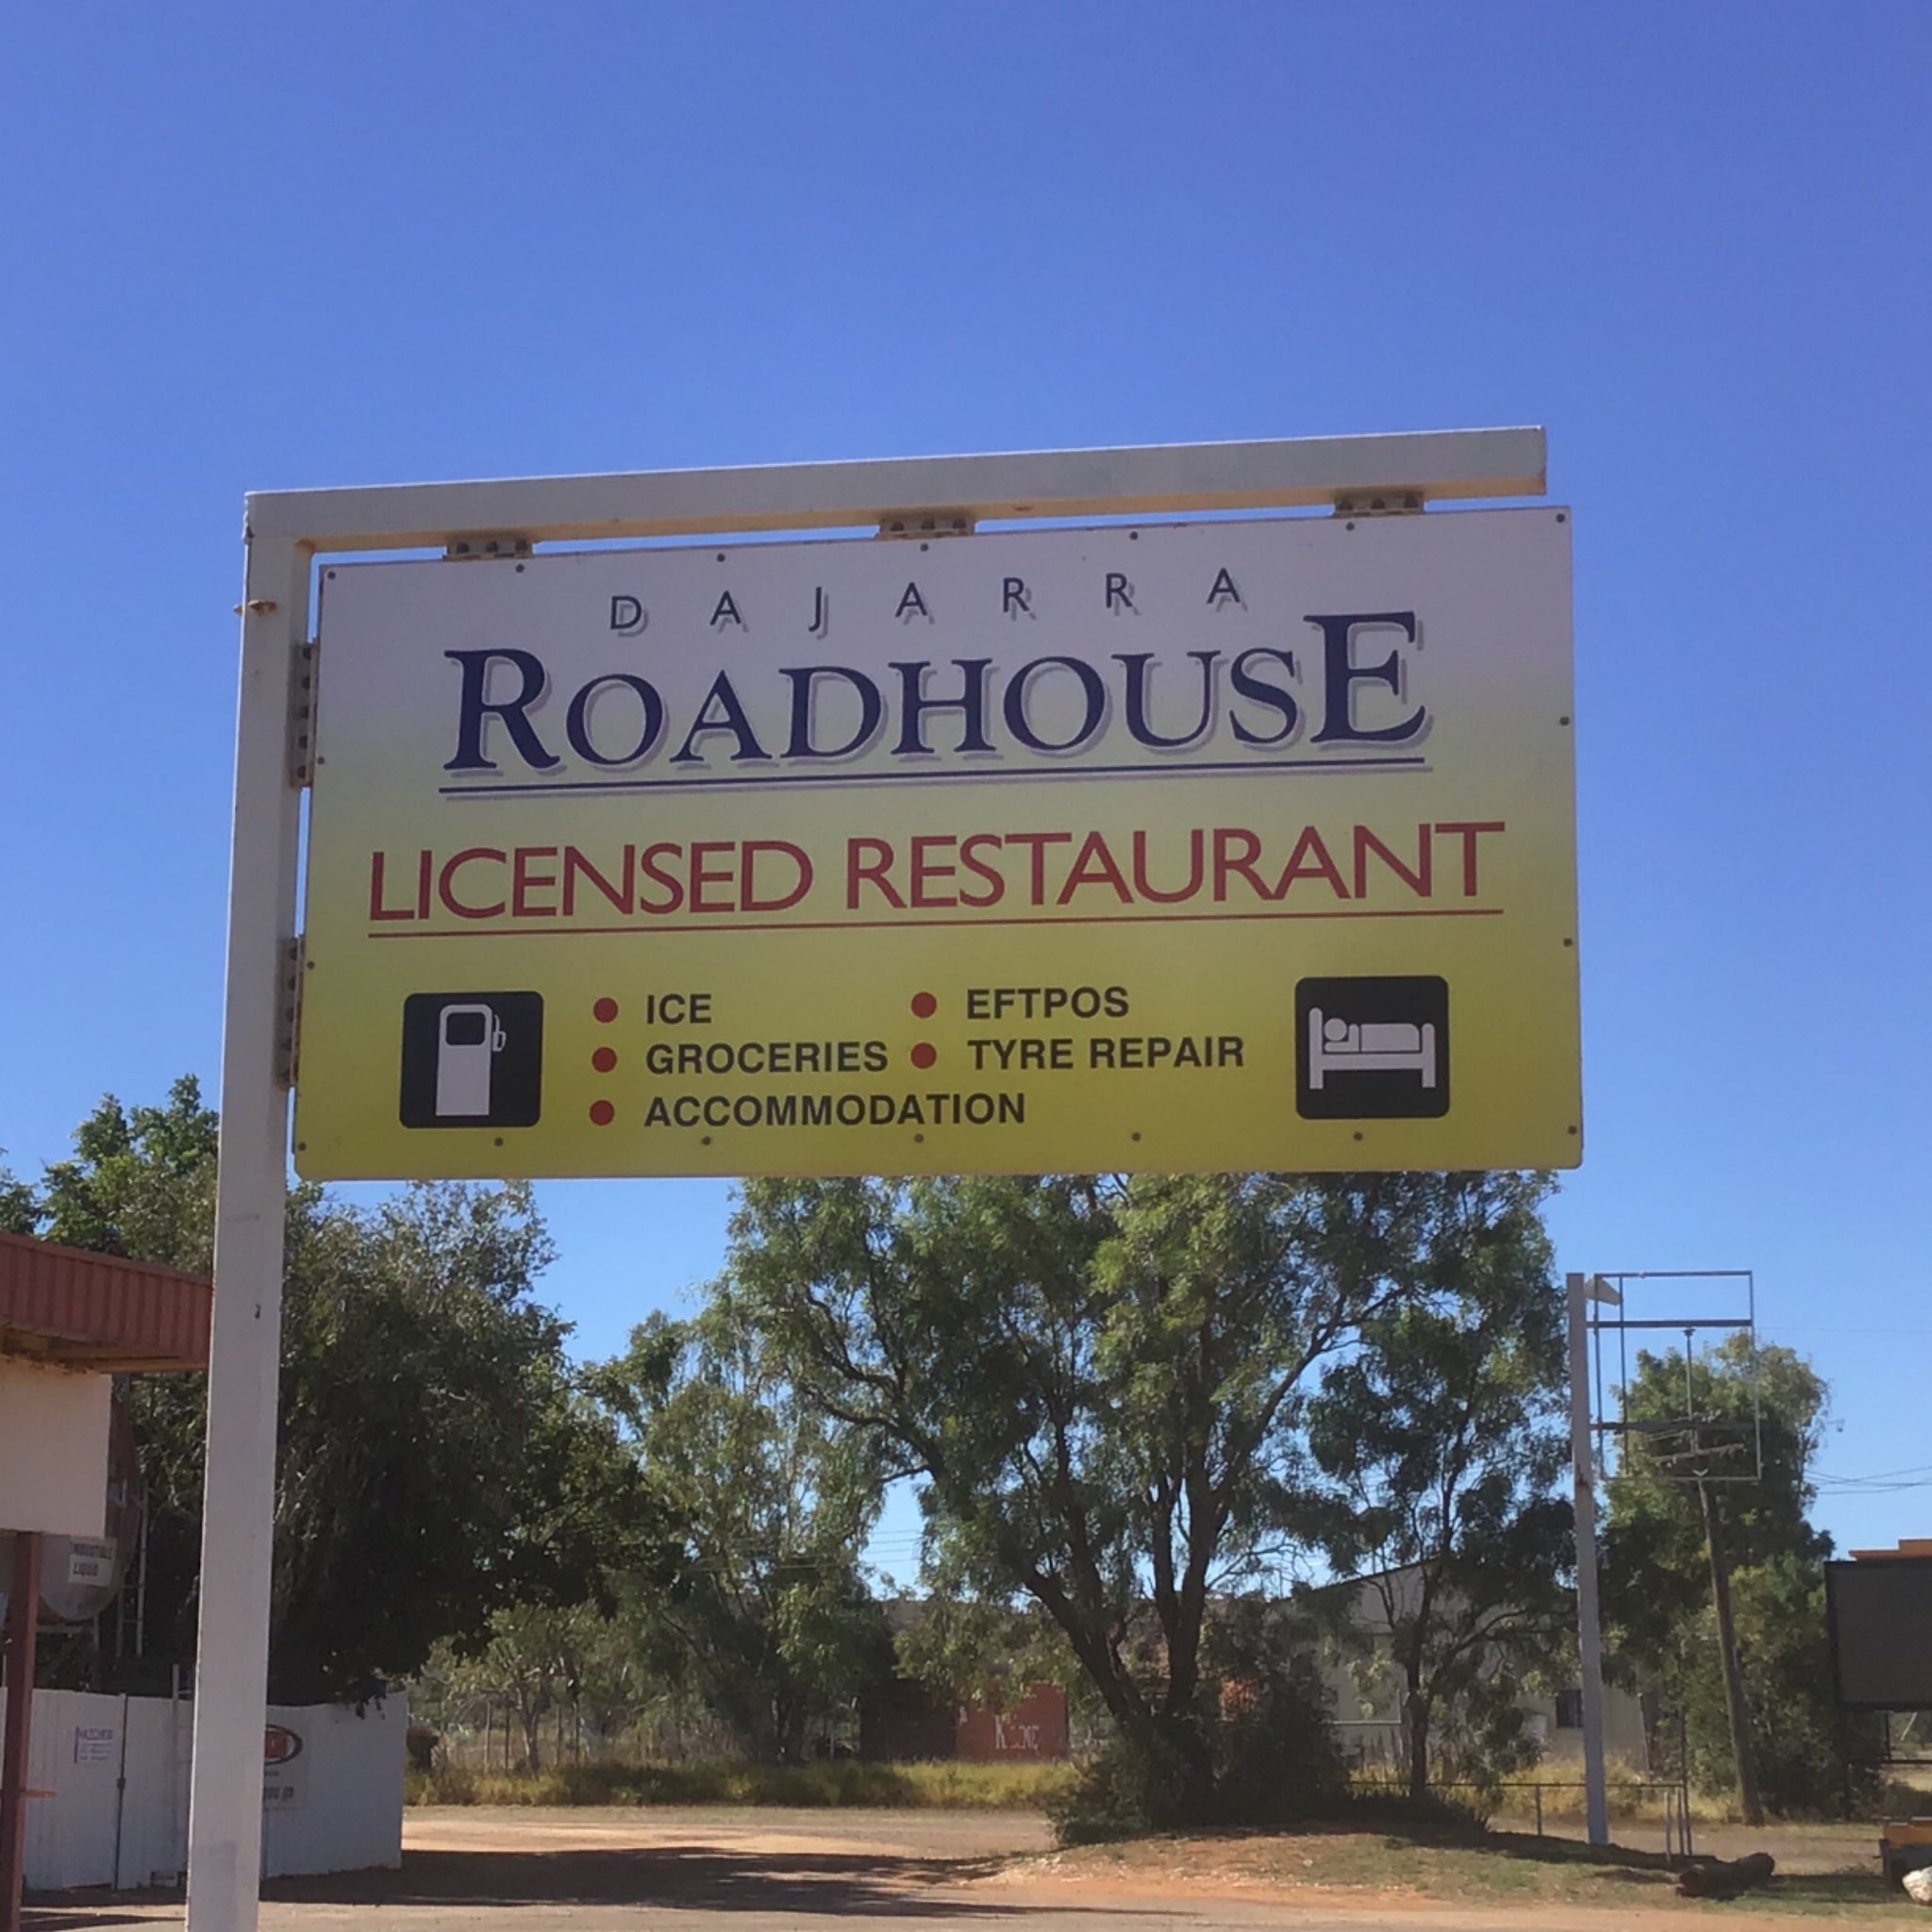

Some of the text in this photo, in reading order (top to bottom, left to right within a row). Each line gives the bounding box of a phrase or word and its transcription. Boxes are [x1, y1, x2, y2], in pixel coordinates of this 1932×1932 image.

[609, 568, 1243, 632] DAJARRA
[443, 611, 1426, 772] ROADHOUSE
[369, 822, 1506, 921] LICENSED RESTAURANT
[646, 993, 712, 1024] ICE
[966, 986, 1130, 1020] EFTPOS
[646, 1041, 889, 1074] GROCERIES
[967, 1036, 1244, 1070] TYRE REPAIR
[644, 1092, 1025, 1127] ACCOMMODATION
